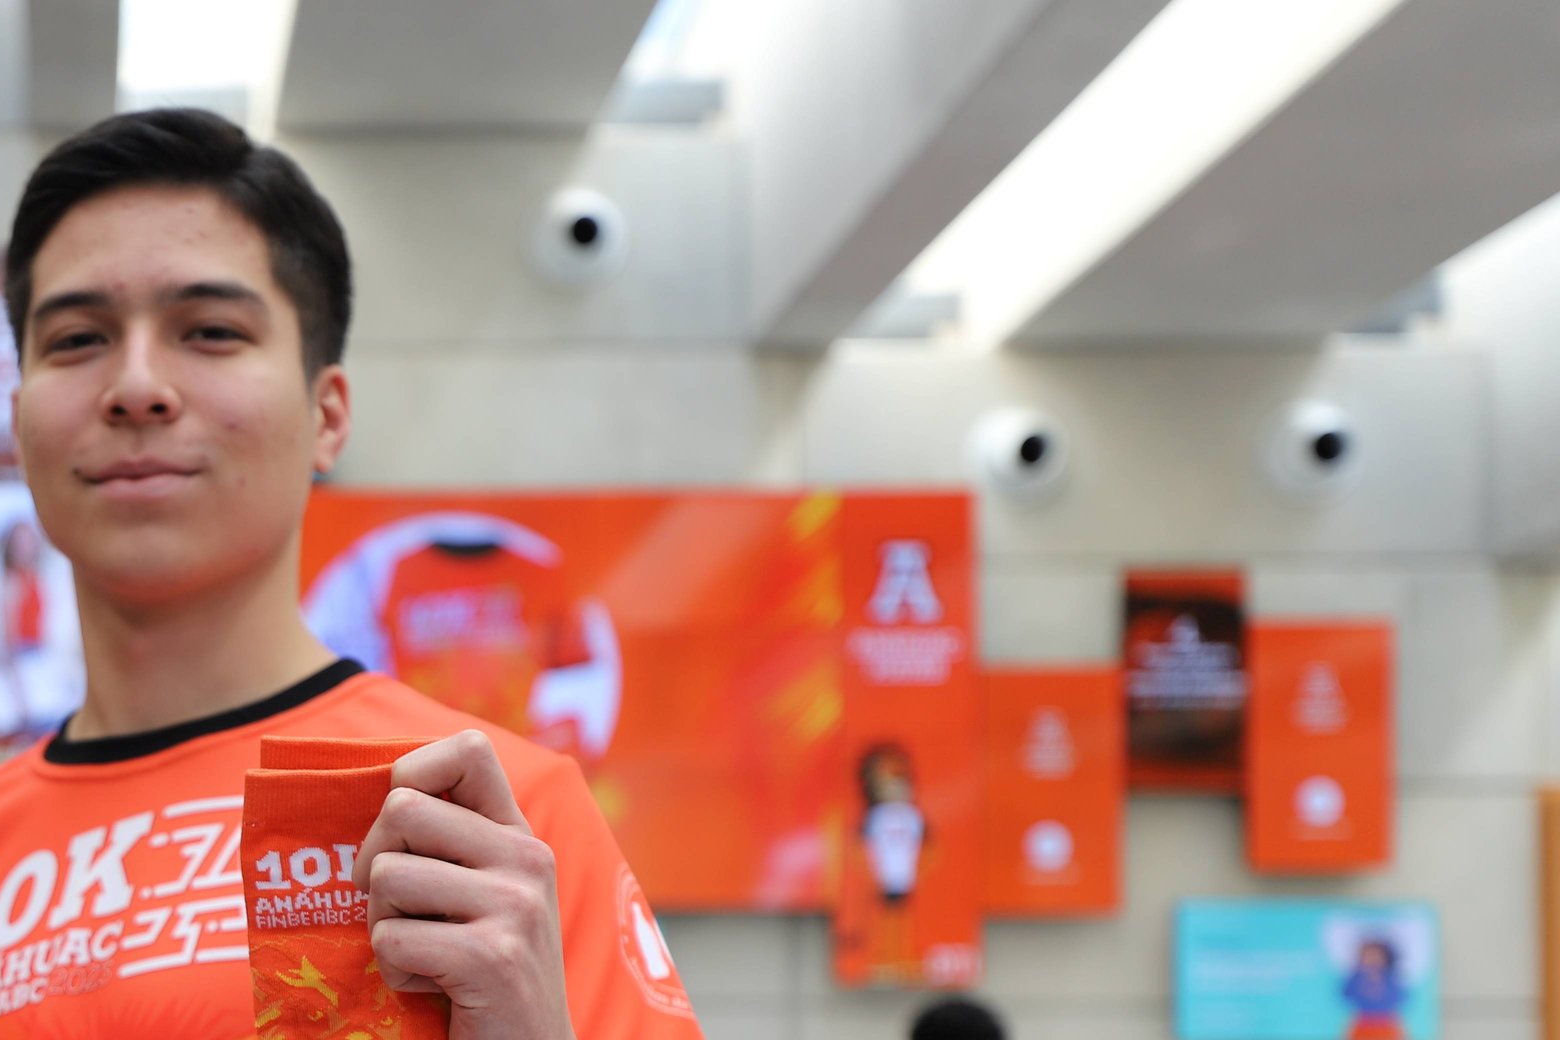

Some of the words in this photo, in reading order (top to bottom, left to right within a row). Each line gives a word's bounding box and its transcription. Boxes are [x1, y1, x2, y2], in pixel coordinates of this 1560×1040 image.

[255, 887, 369, 916] ANÁHUA
[255, 910, 311, 930] FINBE
[312, 907, 352, 926] ABC
